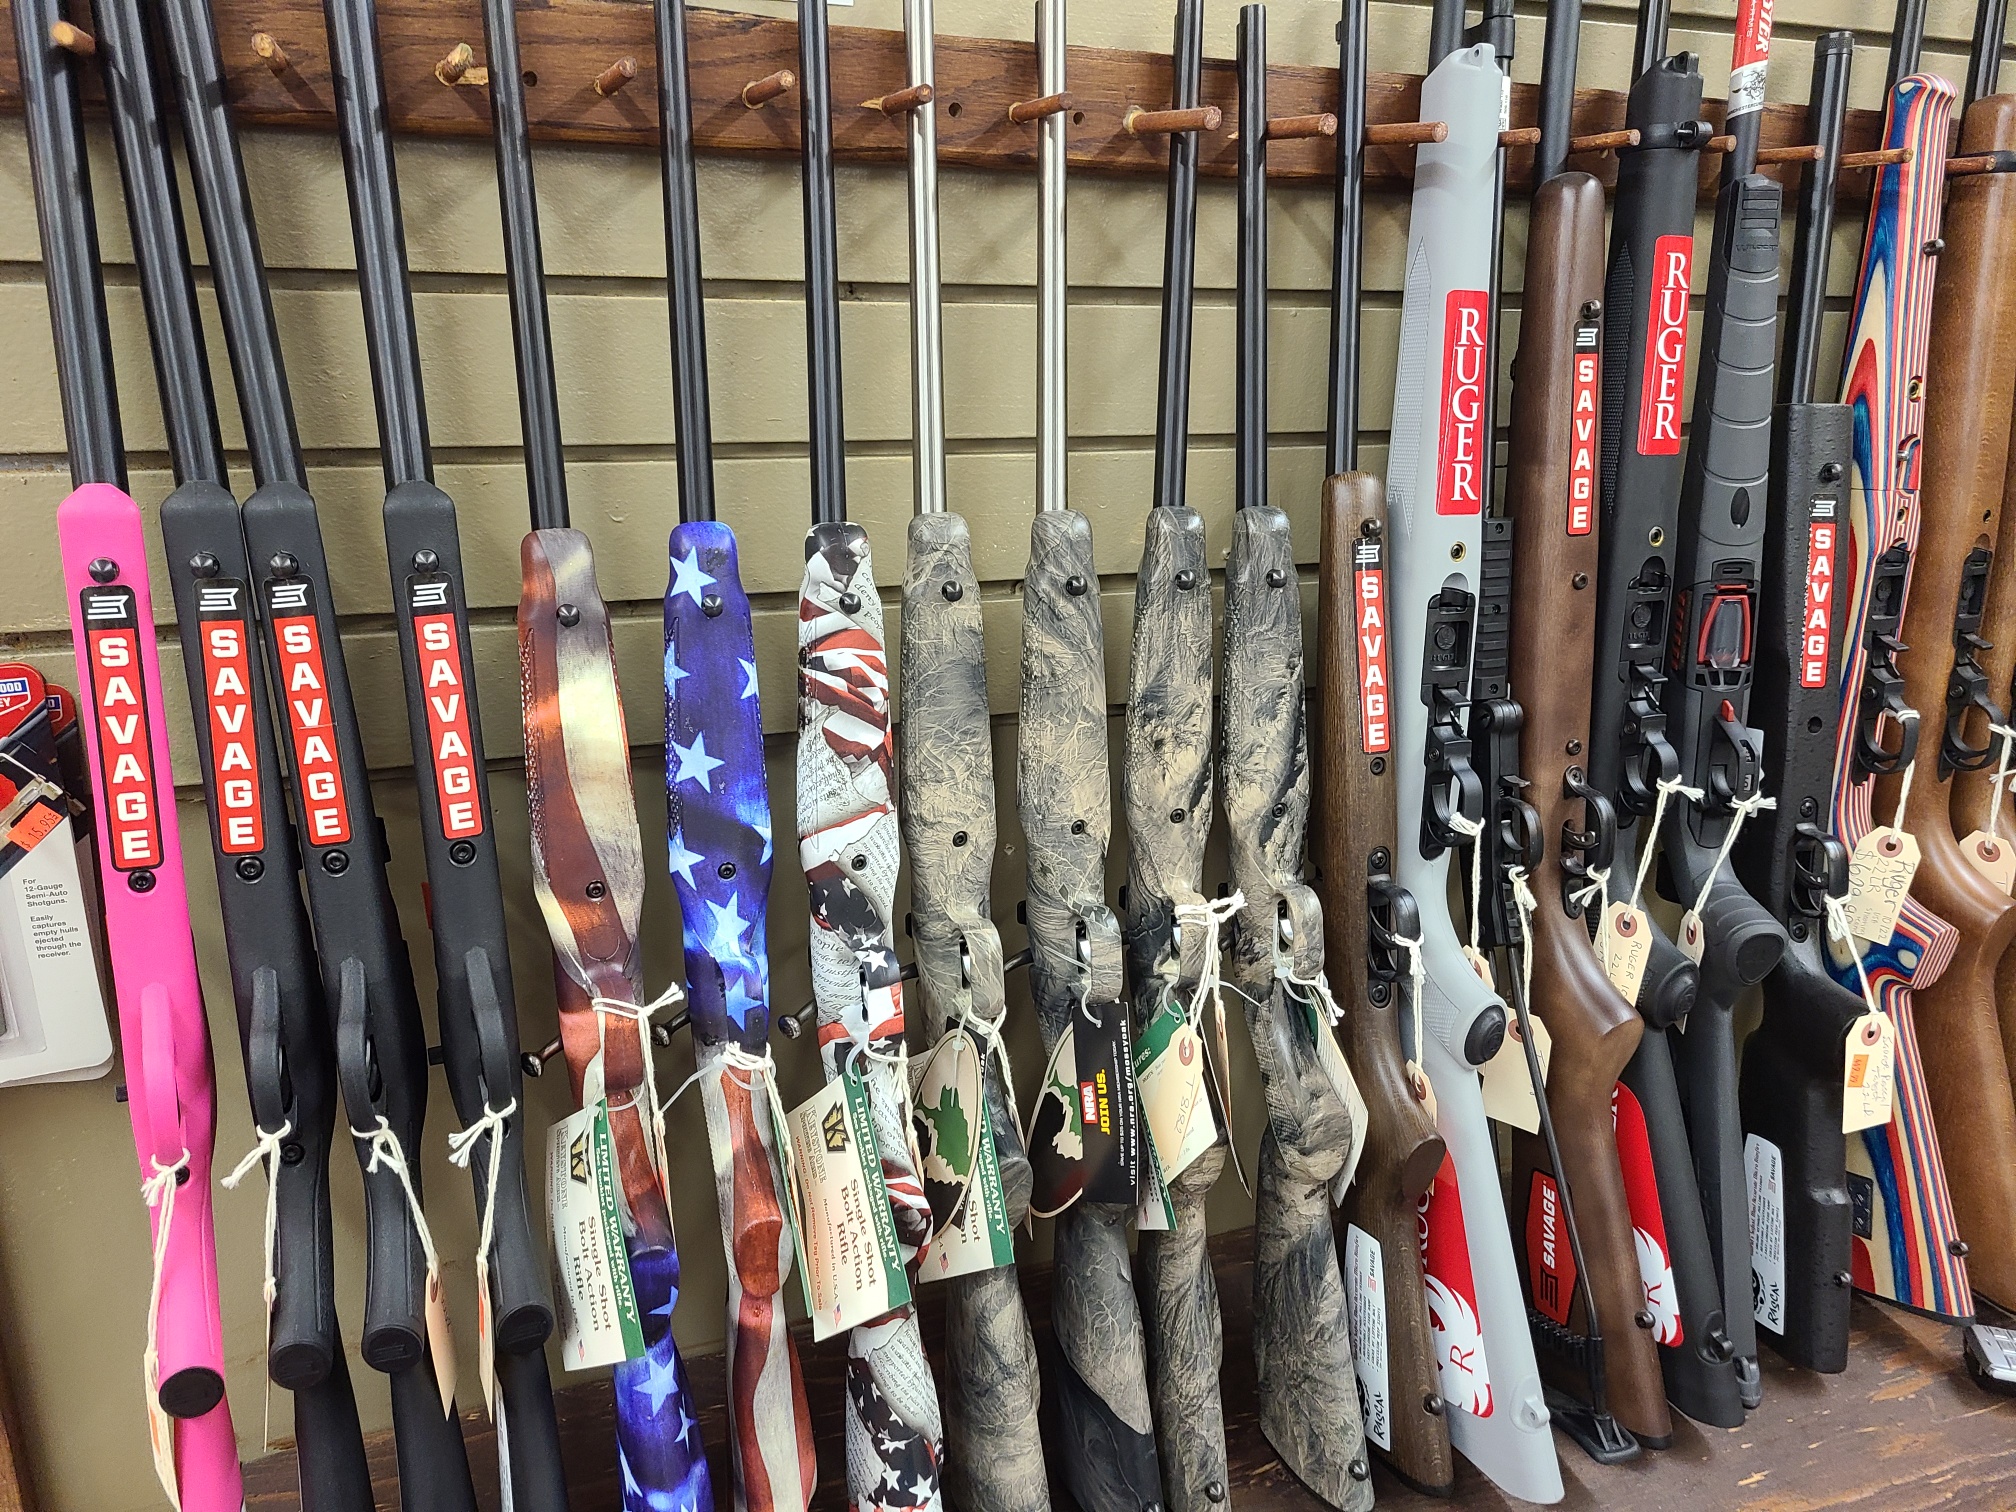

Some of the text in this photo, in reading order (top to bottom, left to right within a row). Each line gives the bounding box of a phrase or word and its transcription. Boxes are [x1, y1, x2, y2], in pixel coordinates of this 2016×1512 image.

[1652, 252, 1690, 440] RUGER
[1448, 307, 1485, 501] RUGER
[1572, 359, 1594, 529] SAVAGE
[1806, 528, 1832, 682] SAVAGE
[1361, 576, 1387, 746] SAVAGE
[98, 637, 151, 860] SAVAGE
[210, 629, 256, 845] SAVAGE
[284, 625, 342, 837] SAVAGE
[423, 622, 475, 831] SAVAGE
[24, 883, 63, 892] 12-Gauge
[25, 890, 68, 900] Semi-Auto
[27, 898, 67, 907] Shotguns.
[1881, 859, 1915, 913] Ruger
[32, 921, 67, 930] captures
[33, 926, 79, 937] empty hulls
[34, 936, 64, 945] ejected
[36, 943, 67, 951] through
[38, 950, 71, 959] receiver.
[1625, 940, 1643, 980] RUGER
[1084, 1086, 1095, 1120] NRA
[1096, 1069, 1110, 1134] JOIN US.
[1121, 1019, 1136, 1157] www.nra.org/mossyoak
[856, 1098, 876, 1167] LIMITED
[872, 1172, 900, 1270] WARRANTY
[983, 1138, 1004, 1233] WARRANTY
[600, 1134, 635, 1322] LIMITED WARRANTY
[823, 1198, 835, 1259] Manufactured
[837, 1222, 847, 1264] Rifle
[841, 1186, 862, 1290] Bolt Action
[851, 1179, 876, 1285] Single Shot
[967, 1200, 980, 1241] Shot
[1543, 1184, 1556, 1269] SAVAGE
[563, 1226, 573, 1292] Manufactured
[573, 1256, 584, 1300] Rifle
[579, 1221, 599, 1331] Bolt Action
[588, 1216, 611, 1329] Single Shot
[816, 1280, 821, 1291] To
[1767, 1281, 1780, 1326] RASCAL
[1449, 1344, 1475, 1377] R
[1373, 1391, 1386, 1441] RASCAL
